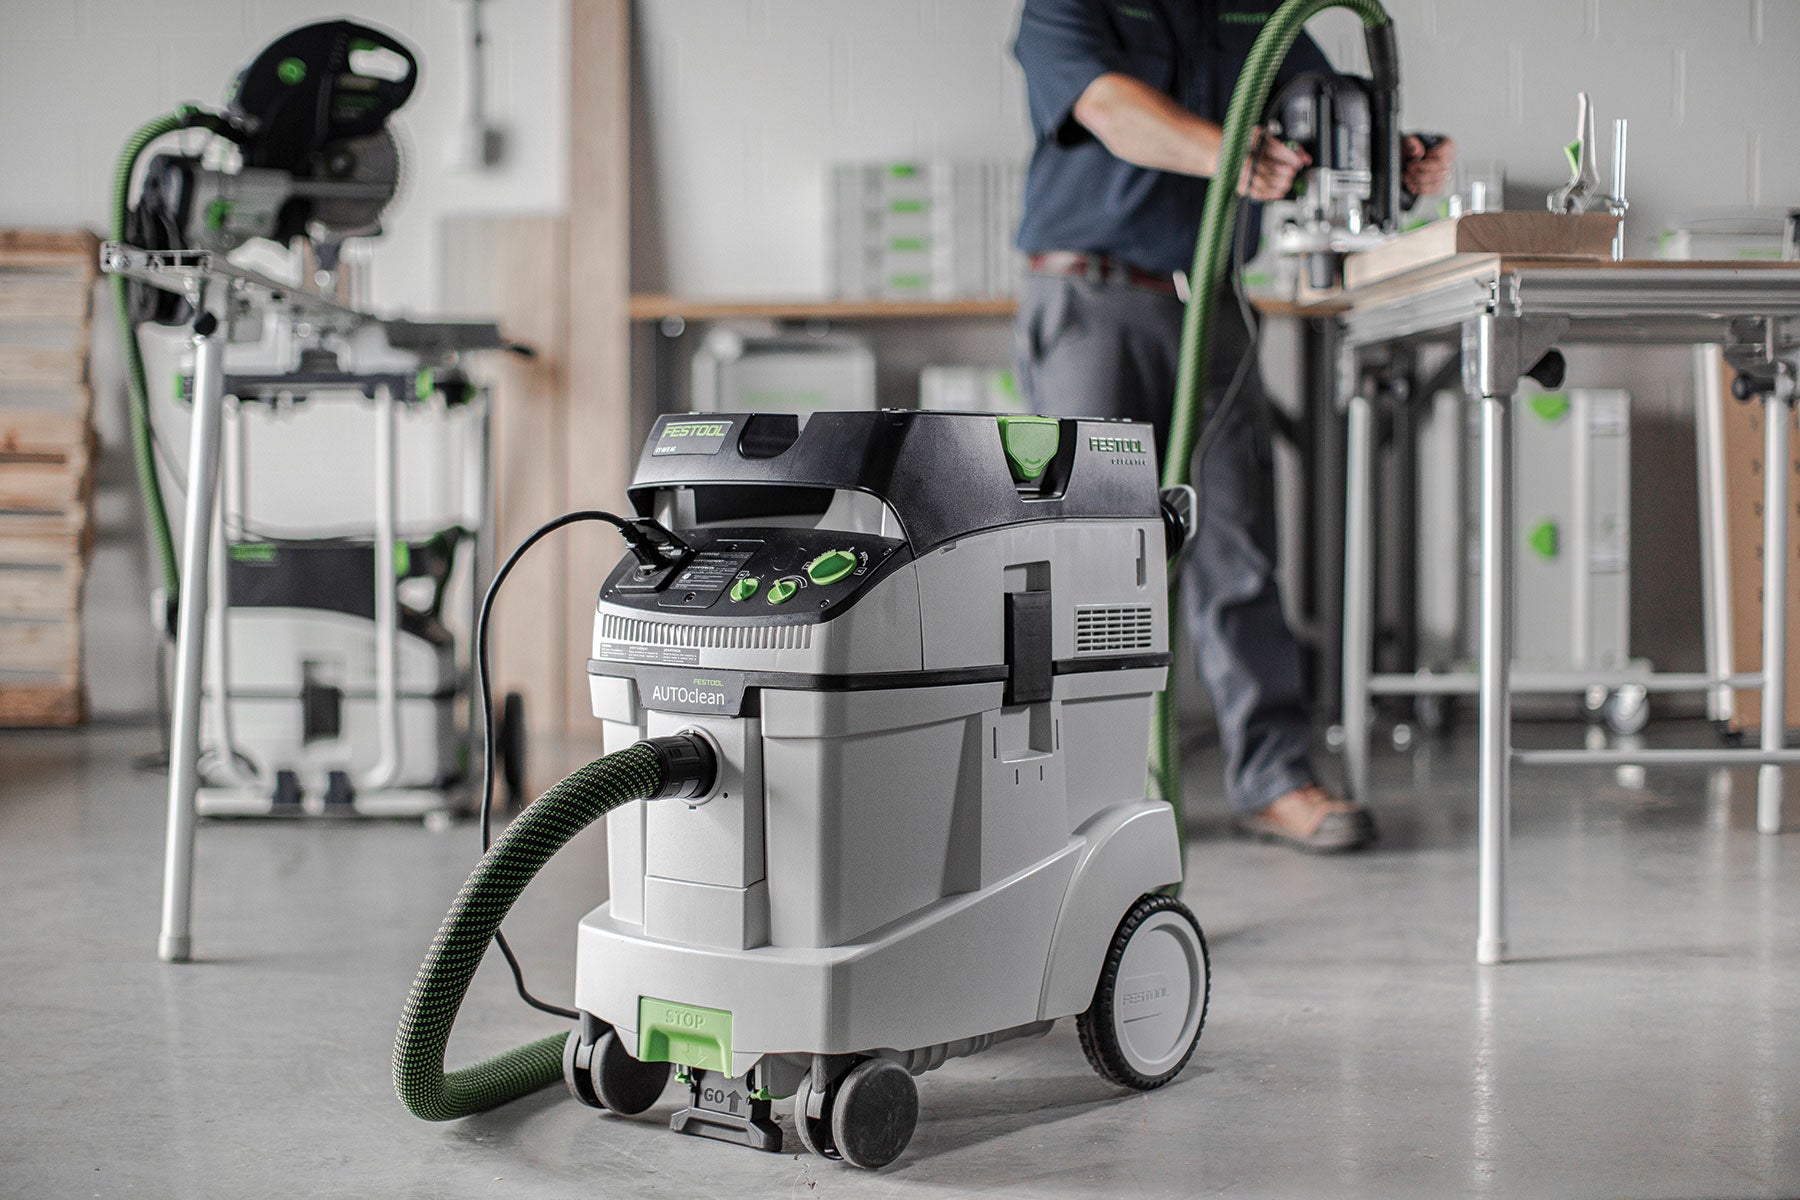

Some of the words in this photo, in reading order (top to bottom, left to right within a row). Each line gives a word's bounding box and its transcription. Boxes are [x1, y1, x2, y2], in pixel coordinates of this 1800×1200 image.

[662, 424, 725, 438] FESTOOL
[1089, 437, 1146, 454] FESTOOL
[693, 678, 724, 687] FESTOOL
[652, 685, 725, 706] AUTOclean
[665, 1008, 705, 1029] STOP
[703, 1087, 725, 1104] GO
